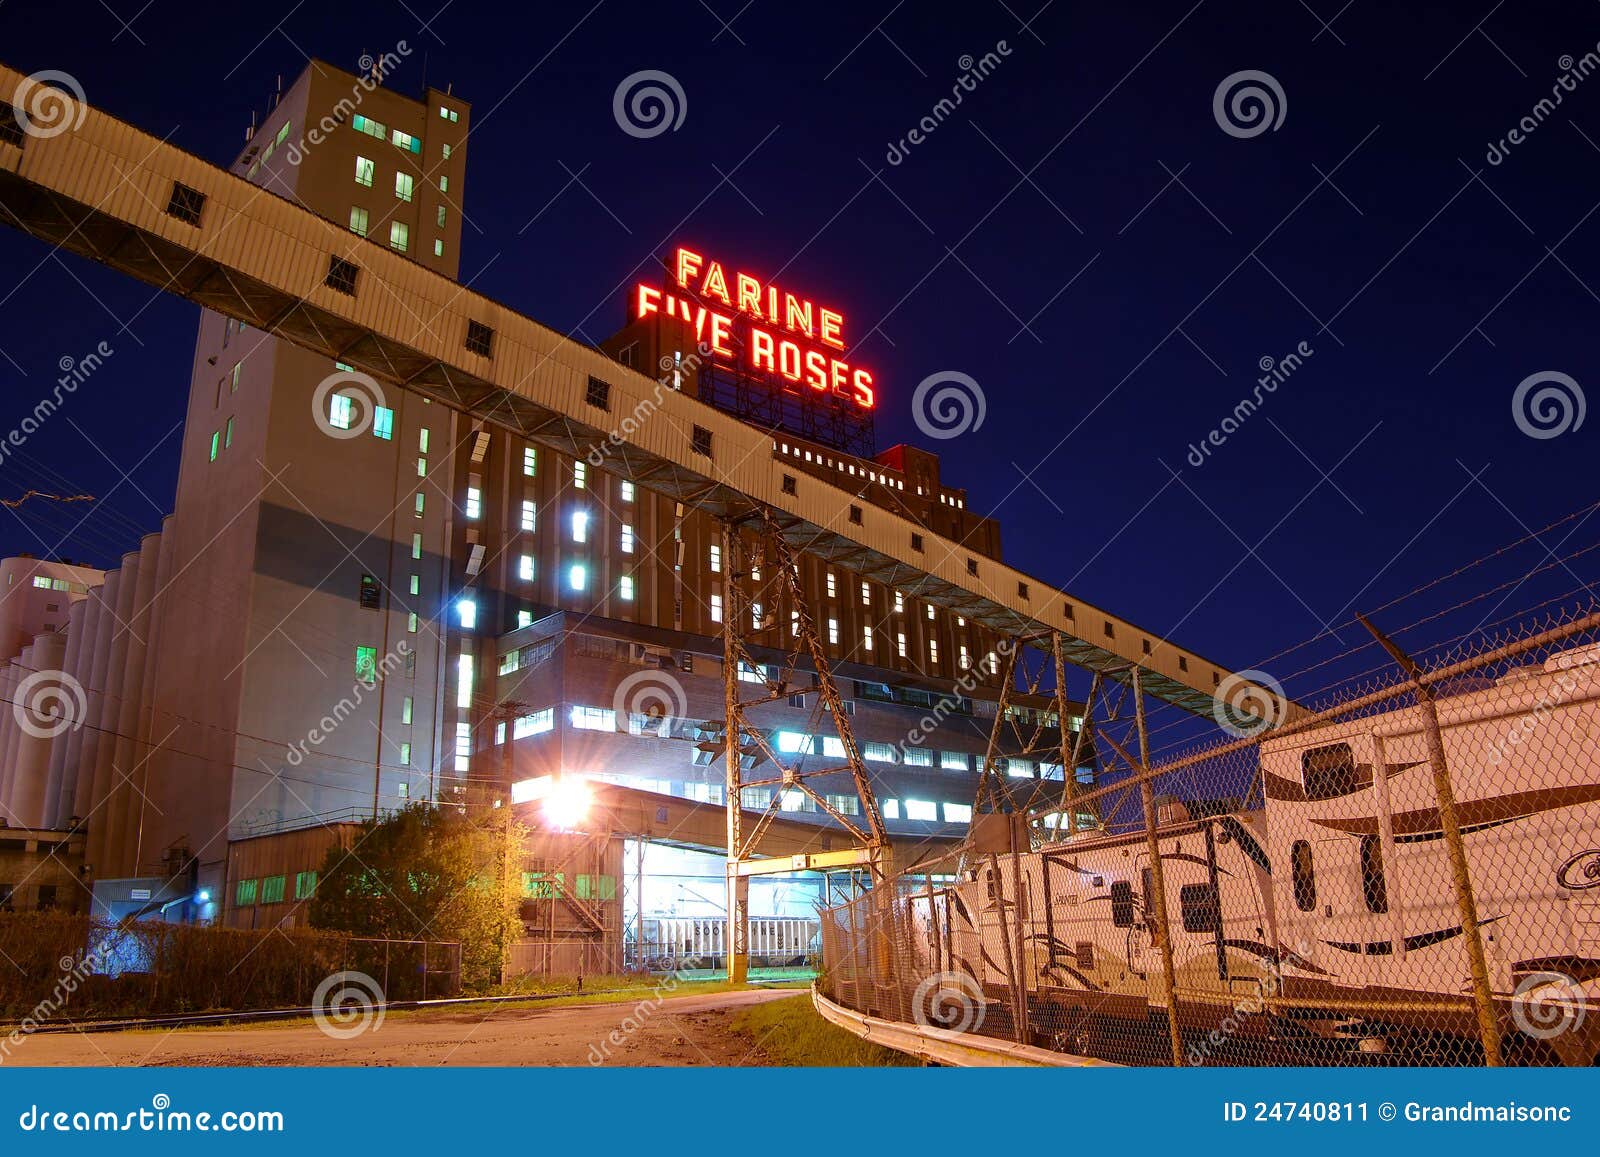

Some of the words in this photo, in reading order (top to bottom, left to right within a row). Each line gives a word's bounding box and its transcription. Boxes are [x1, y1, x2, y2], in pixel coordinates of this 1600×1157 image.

[638, 284, 732, 357] FIVE
[752, 327, 875, 408] ROSES
[677, 248, 844, 351] FARINE
[695, 926, 720, 937] SOO
[752, 927, 775, 936] INE
